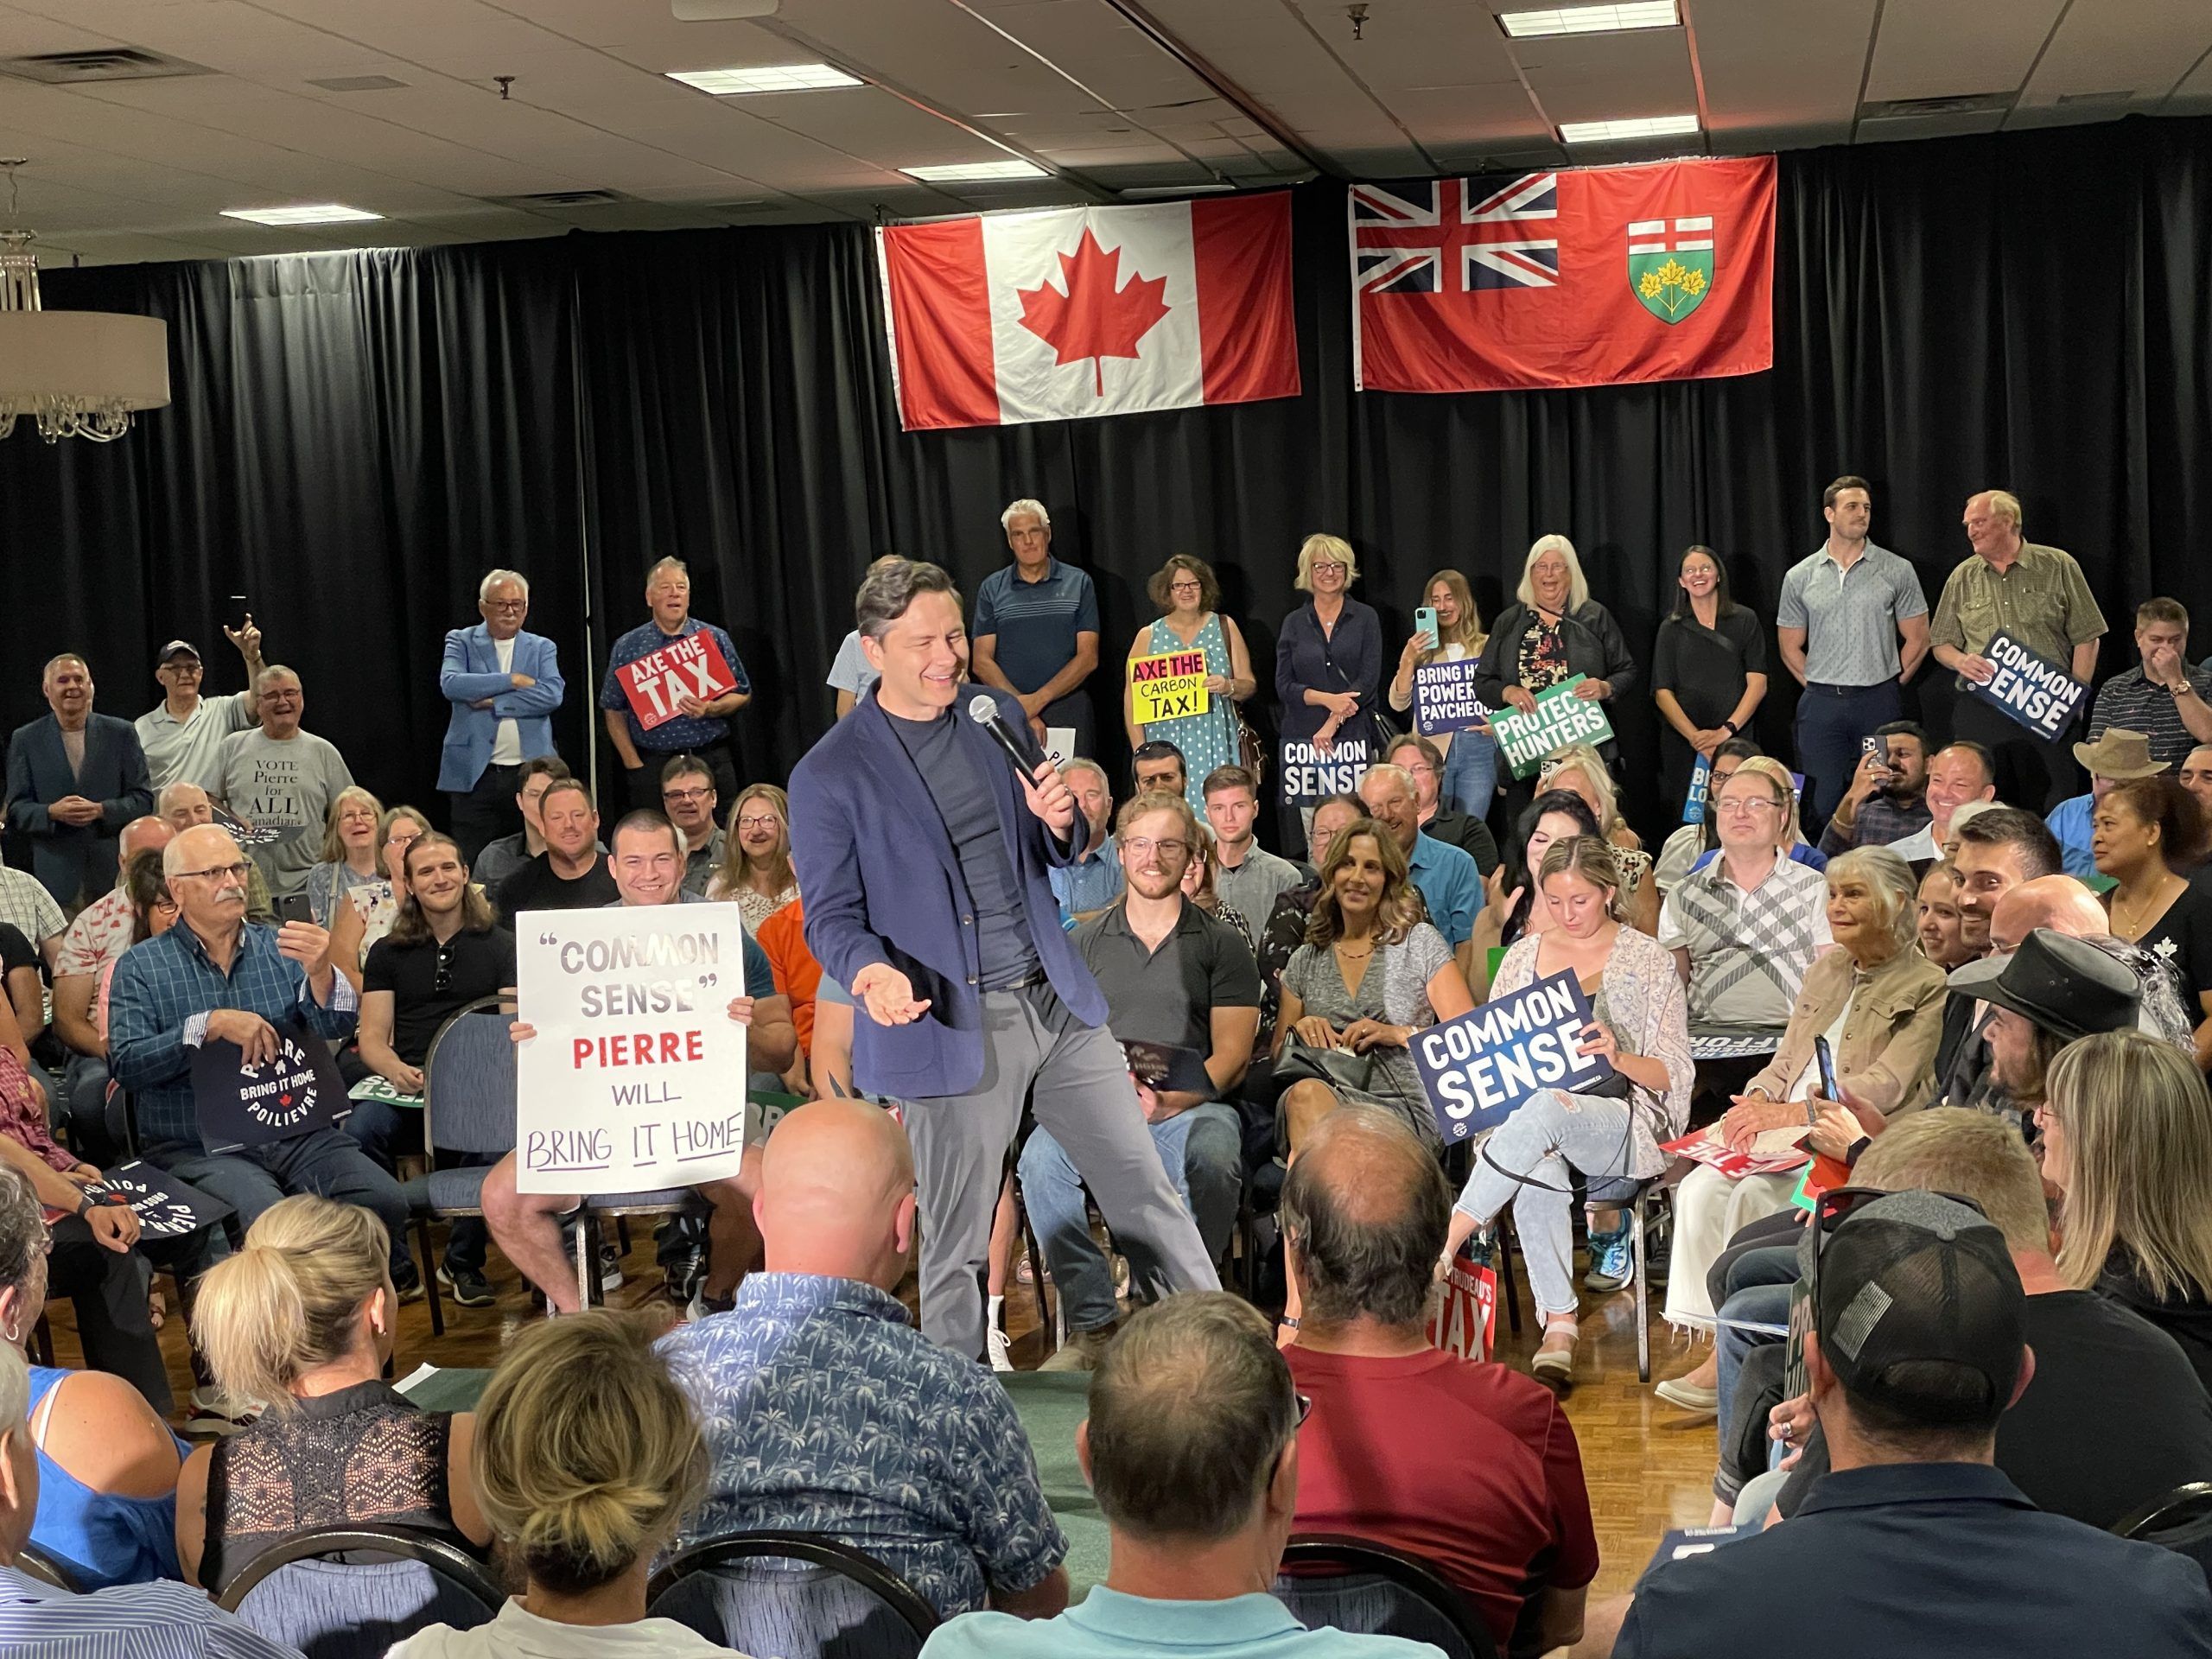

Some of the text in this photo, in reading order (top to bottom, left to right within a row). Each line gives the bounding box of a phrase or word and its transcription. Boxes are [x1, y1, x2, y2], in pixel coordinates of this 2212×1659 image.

[631, 635, 705, 683] AXE THE
[1133, 654, 1204, 683] AXE THE
[1417, 664, 1461, 684] BRING
[1991, 637, 2082, 705] COMMON
[636, 654, 724, 717] TAX
[1141, 677, 1197, 697] CARBON
[1149, 691, 1198, 719] TAX!
[1494, 691, 1590, 745] PROTEC
[1285, 740, 1367, 764] COMMON
[1503, 707, 1605, 768] HUNTERS
[254, 771, 298, 784] Pierre
[256, 760, 299, 771] VOTE
[249, 797, 299, 815] ALL
[265, 785, 283, 795] for
[1422, 979, 1576, 1070] COMMON
[574, 1030, 703, 1069] PIERRE
[240, 1069, 316, 1101] BRING IT HOME
[1437, 1018, 1596, 1119] SENSE
[247, 1087, 317, 1127] POILIEVRE
[612, 1082, 682, 1106] WILL
[526, 1128, 612, 1169] BRING
[633, 1123, 661, 1159] IT
[672, 1112, 742, 1154] HOME
[1433, 1281, 1491, 1363] TAX
